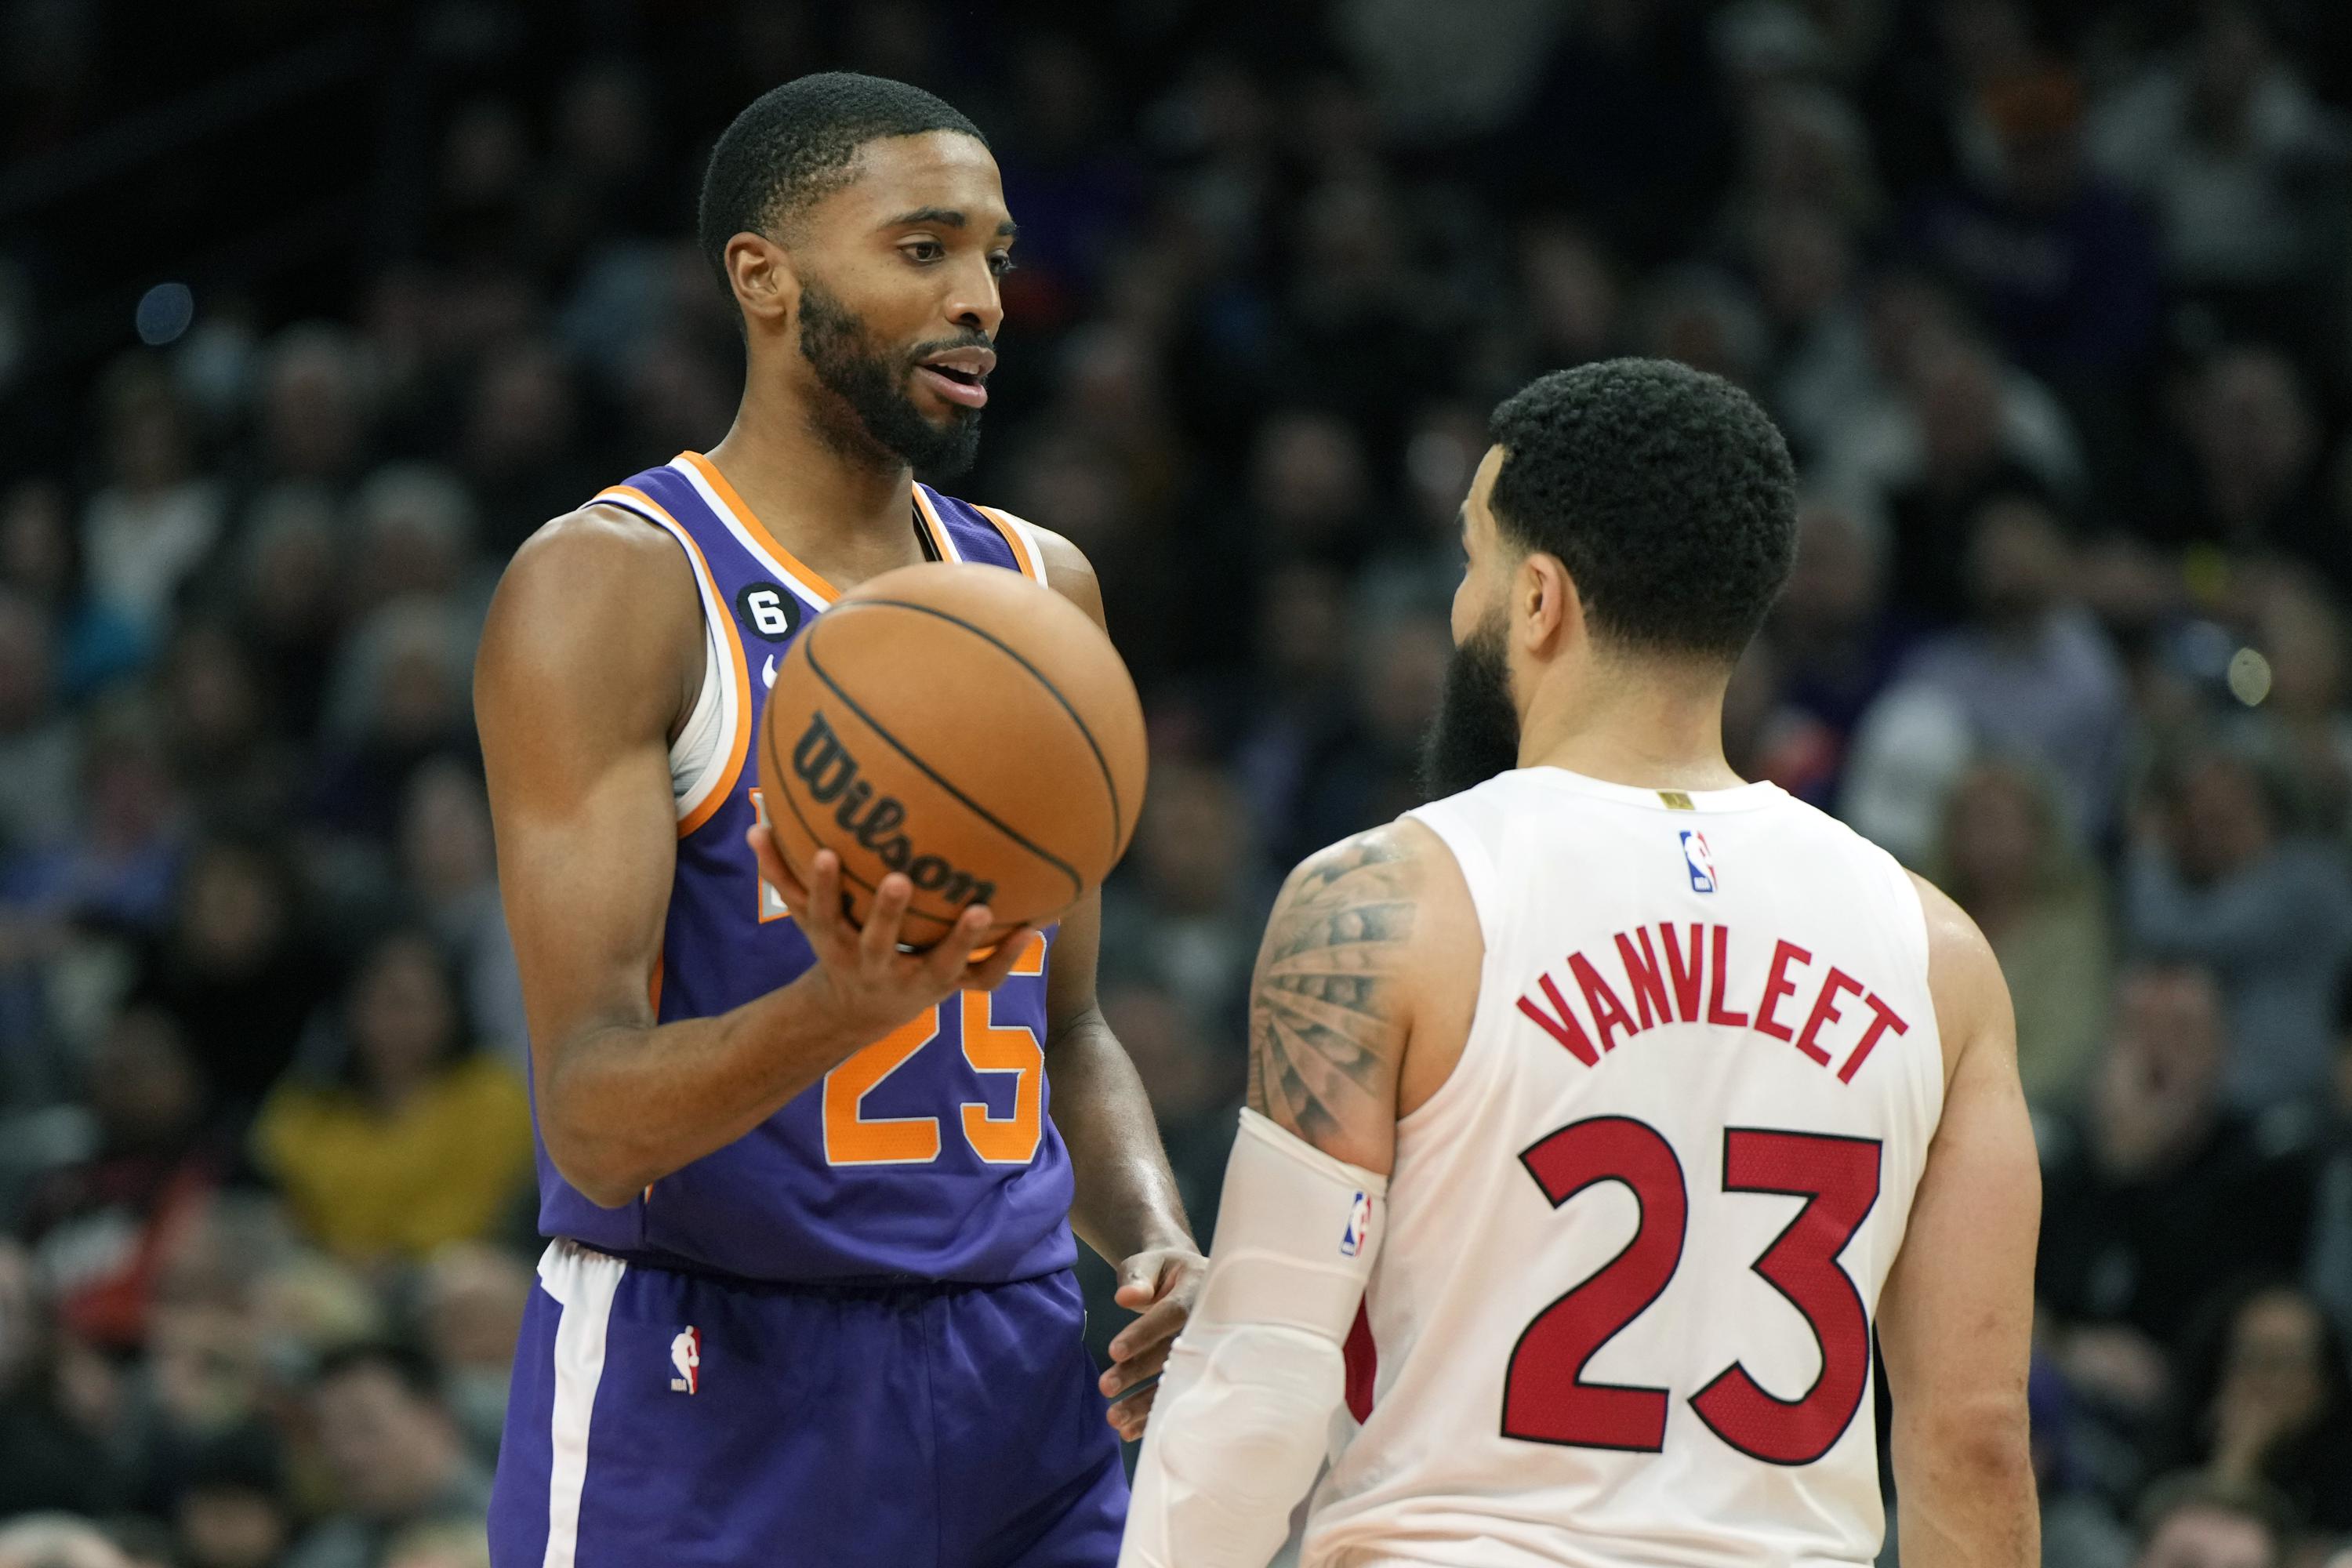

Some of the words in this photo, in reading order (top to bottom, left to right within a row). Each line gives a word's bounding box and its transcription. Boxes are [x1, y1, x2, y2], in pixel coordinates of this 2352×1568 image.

[747, 590, 789, 634] 6
[793, 710, 996, 905] Wilson
[821, 930, 1047, 1167] 25
[1516, 921, 1910, 1085] VANVLEET
[1499, 1113, 1884, 1467] 23
